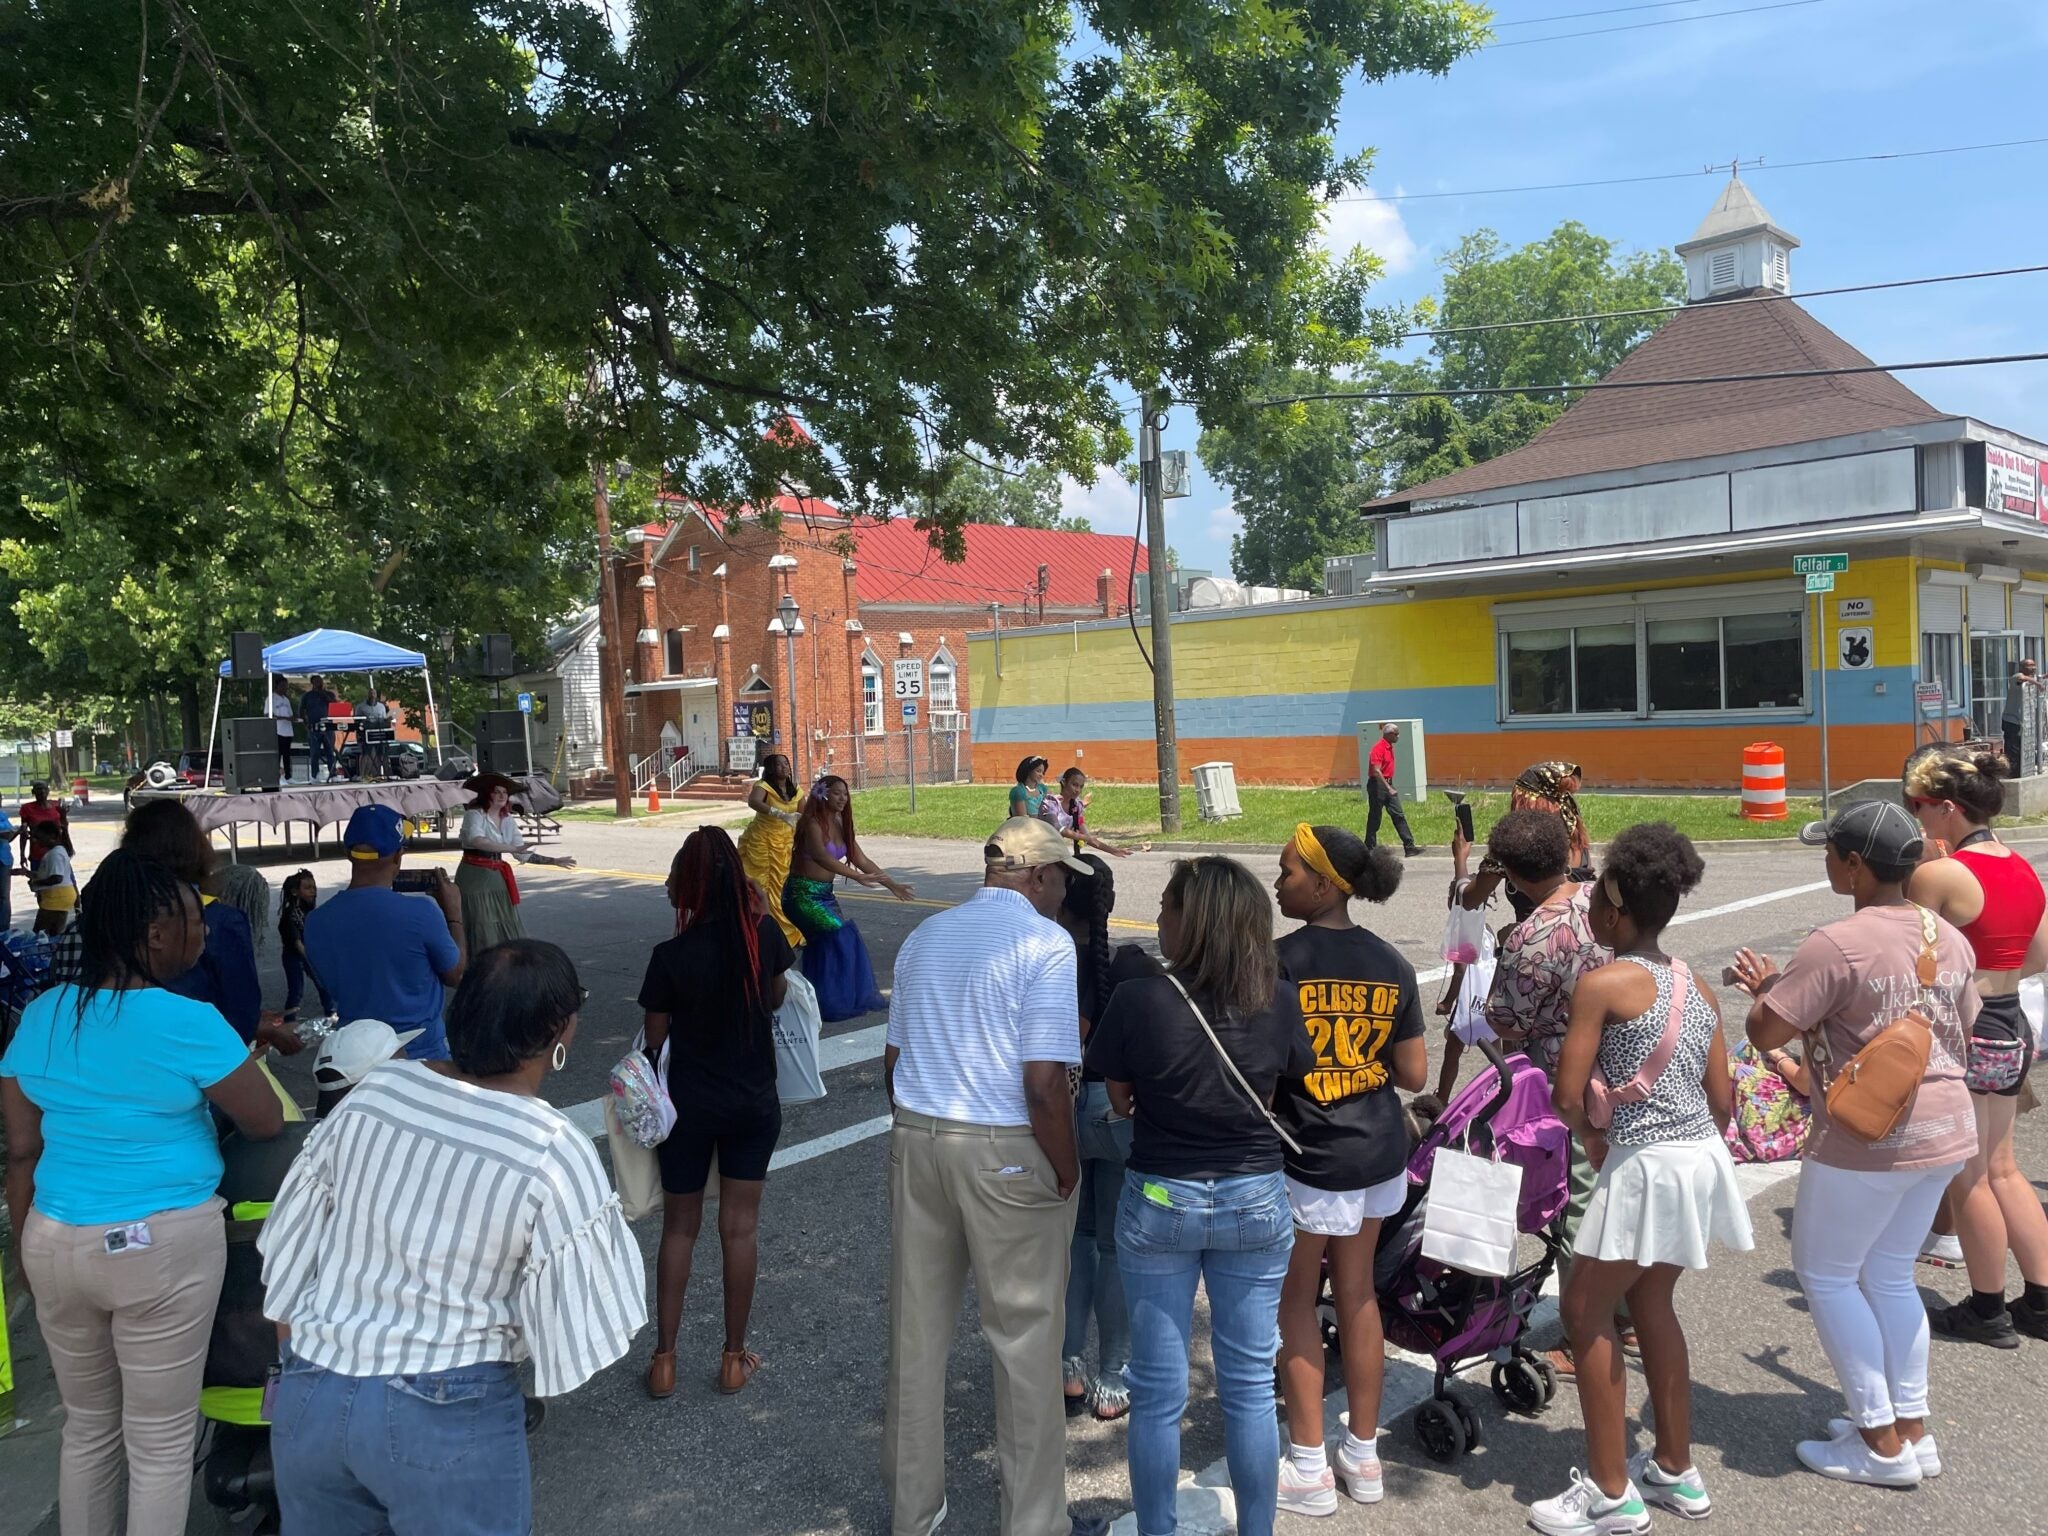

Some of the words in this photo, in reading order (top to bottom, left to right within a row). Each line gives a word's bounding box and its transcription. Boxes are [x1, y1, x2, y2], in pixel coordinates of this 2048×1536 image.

[1797, 557, 1832, 571] Telfair
[1847, 601, 1864, 610] NO
[895, 663, 921, 671] SPEED
[896, 680, 921, 695] 35
[755, 712, 767, 725] 100
[1299, 984, 1368, 1013] CLASS
[1371, 986, 1399, 1015] OF
[1304, 1016, 1393, 1067] 2027
